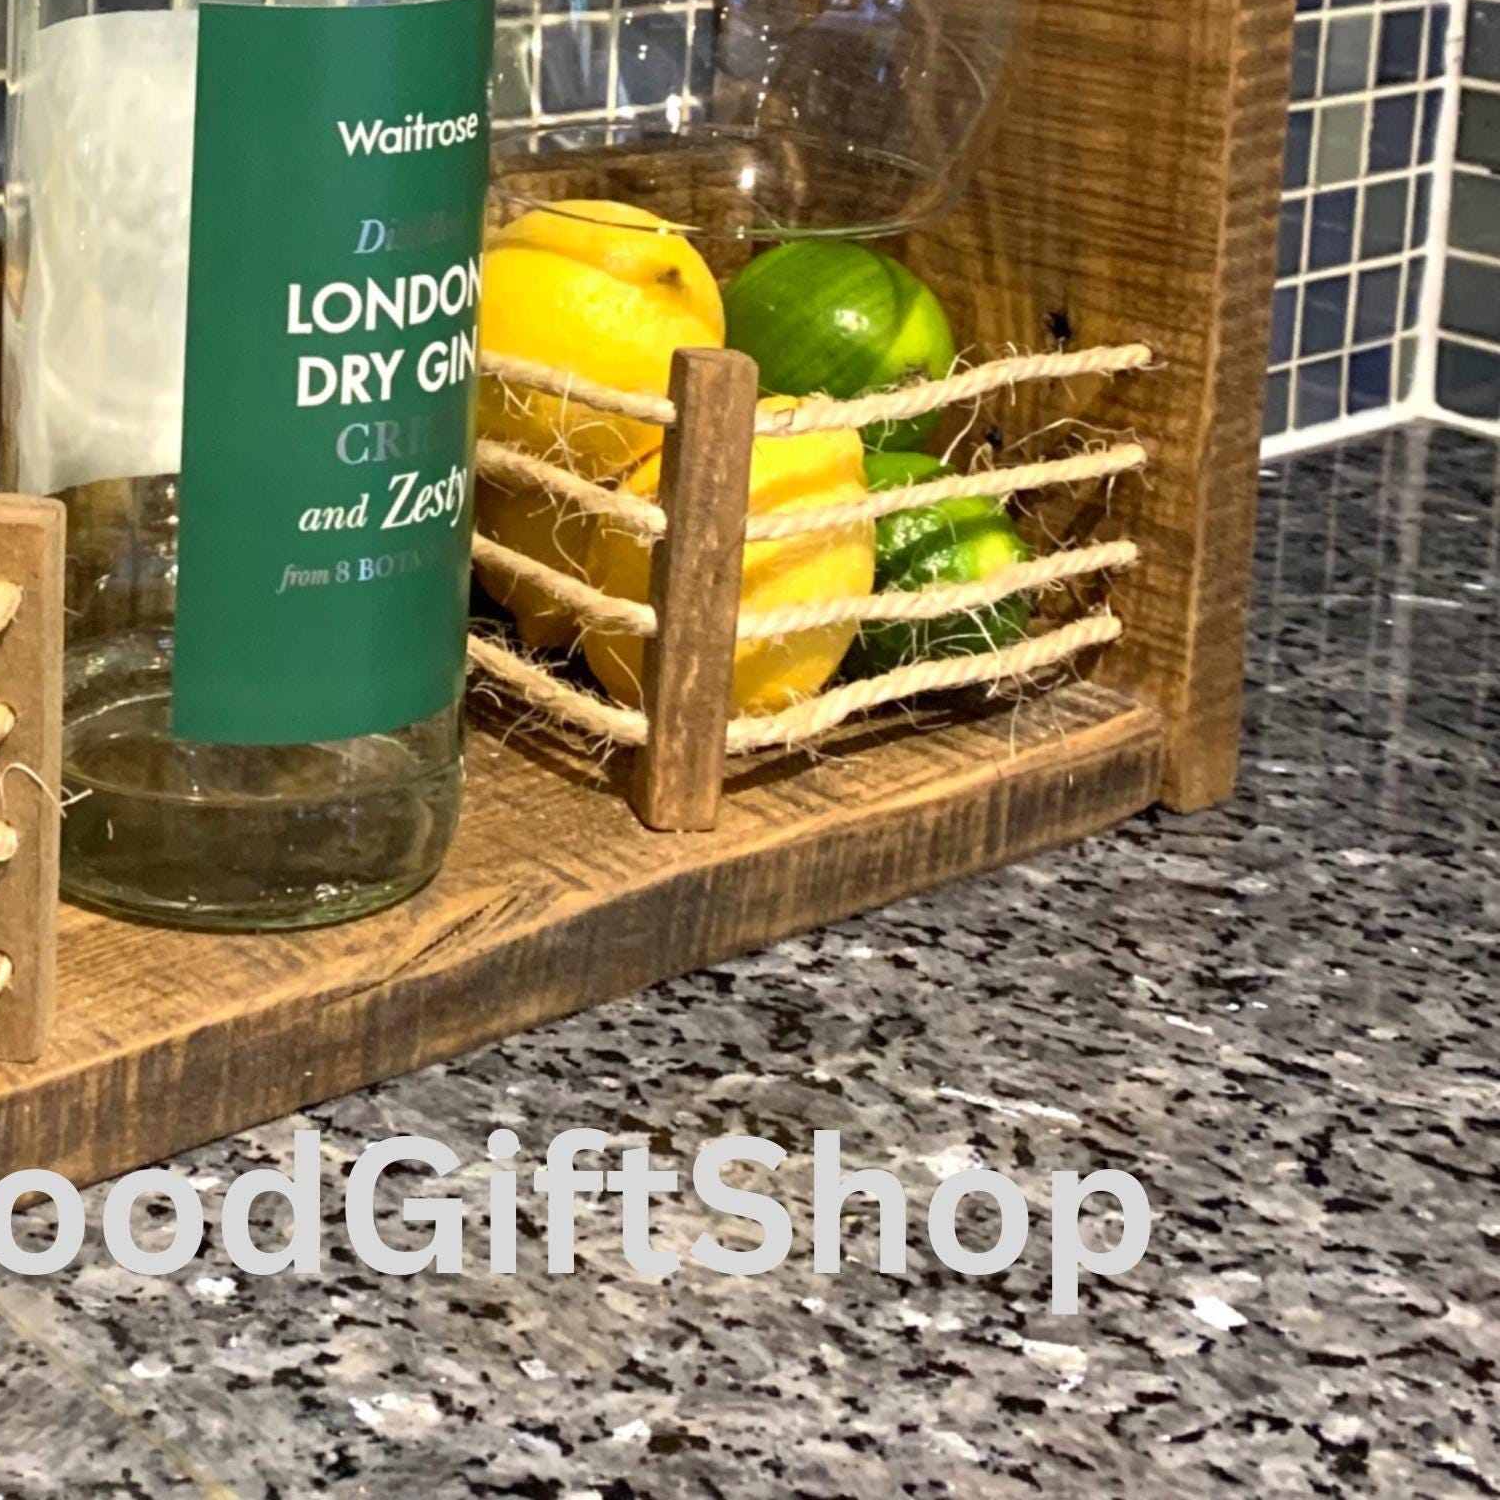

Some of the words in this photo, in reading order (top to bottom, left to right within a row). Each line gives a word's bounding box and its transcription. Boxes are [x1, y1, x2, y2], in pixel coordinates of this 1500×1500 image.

[337, 111, 478, 156] Waitrose
[287, 252, 483, 334] LONDON
[296, 348, 405, 407] DRY
[417, 324, 477, 392] GIN
[299, 493, 369, 531] and
[380, 464, 467, 530] Zesty
[276, 564, 330, 595] from
[335, 560, 351, 583] 8
